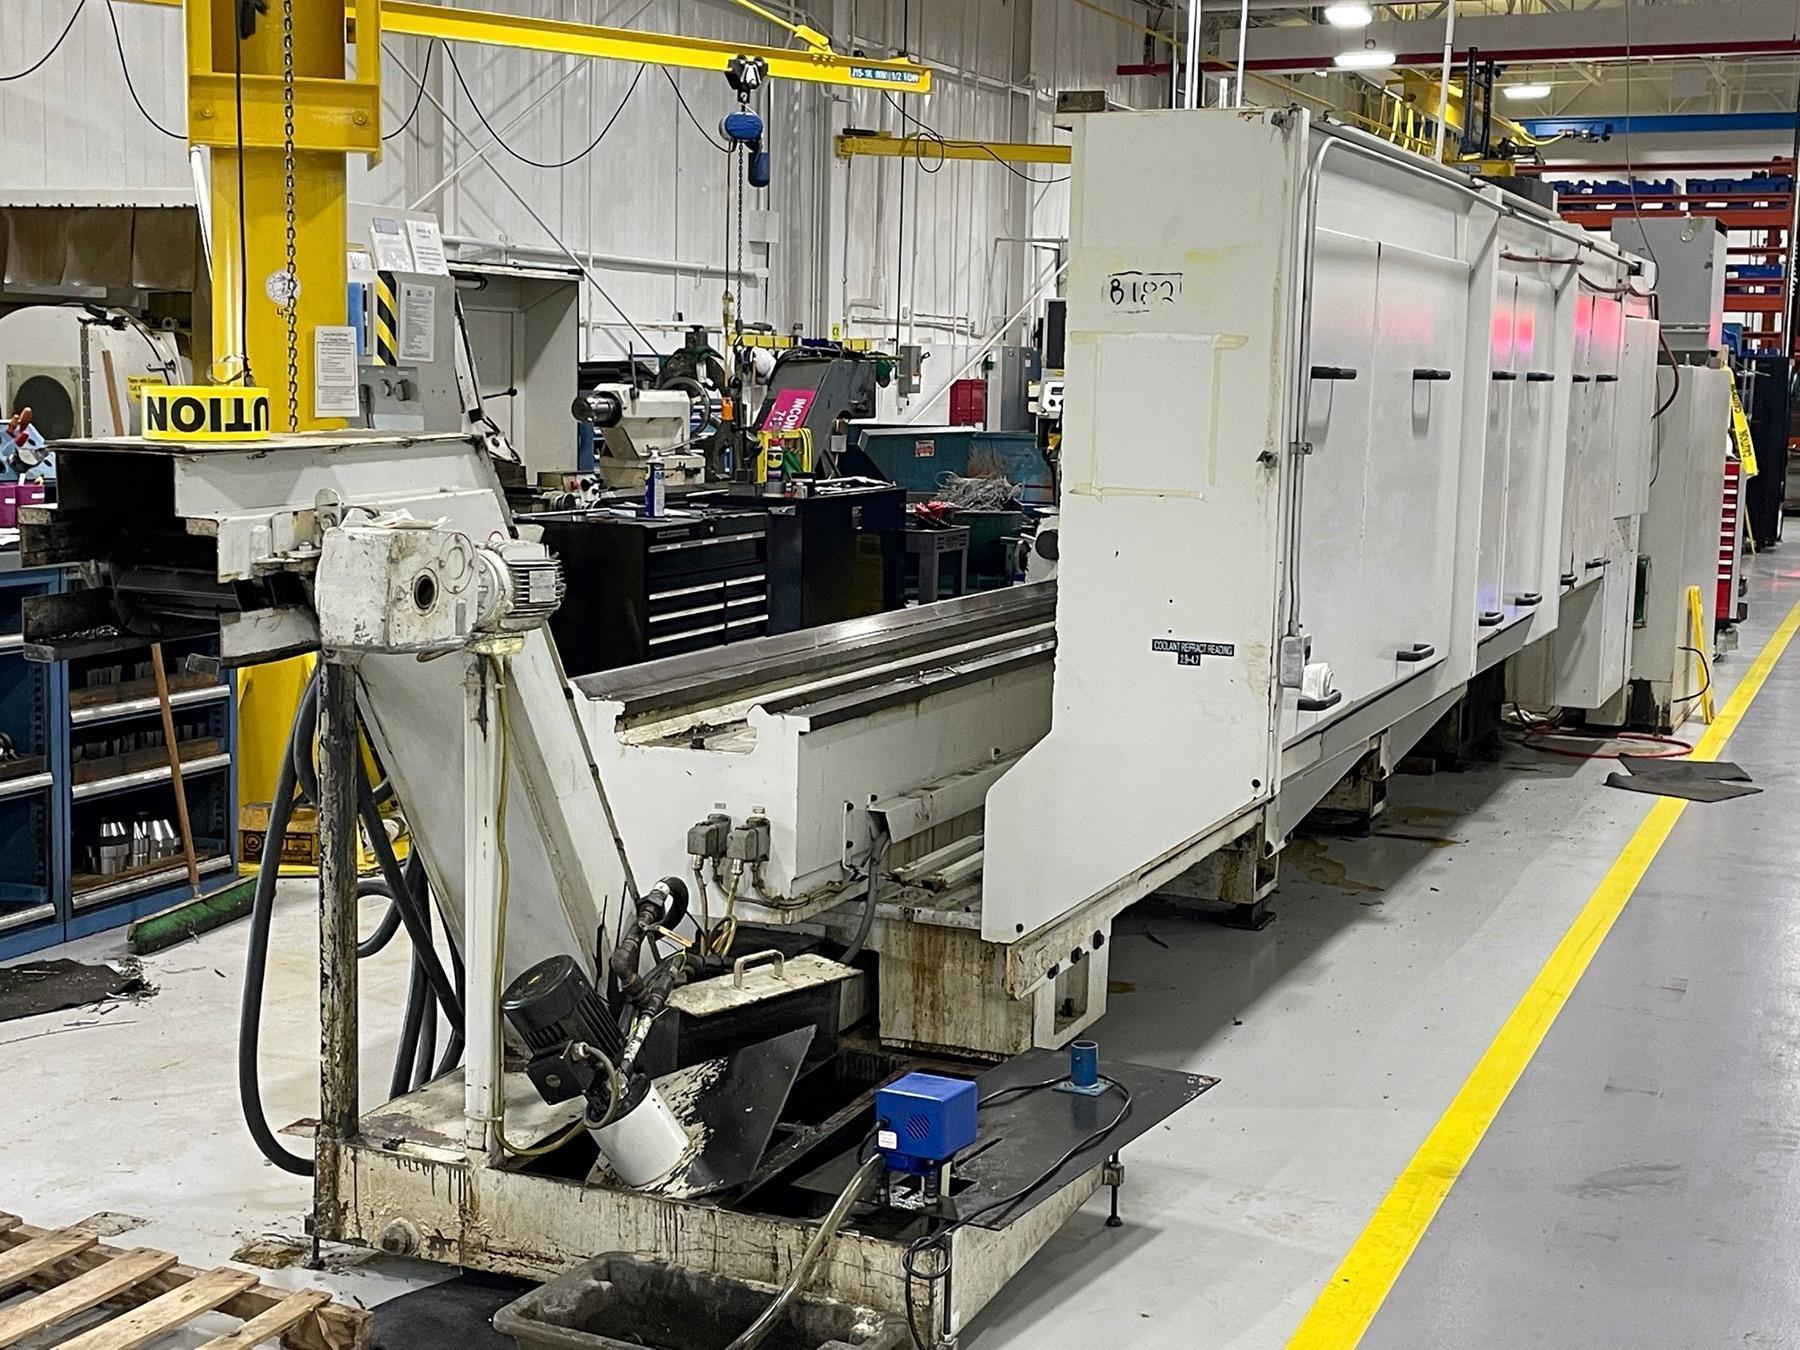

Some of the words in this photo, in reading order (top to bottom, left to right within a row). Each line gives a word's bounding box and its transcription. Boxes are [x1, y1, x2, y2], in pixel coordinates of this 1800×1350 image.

[1153, 640, 1180, 652] COOLANT
[1180, 642, 1207, 654] REFRACT
[1207, 644, 1233, 656] READING
